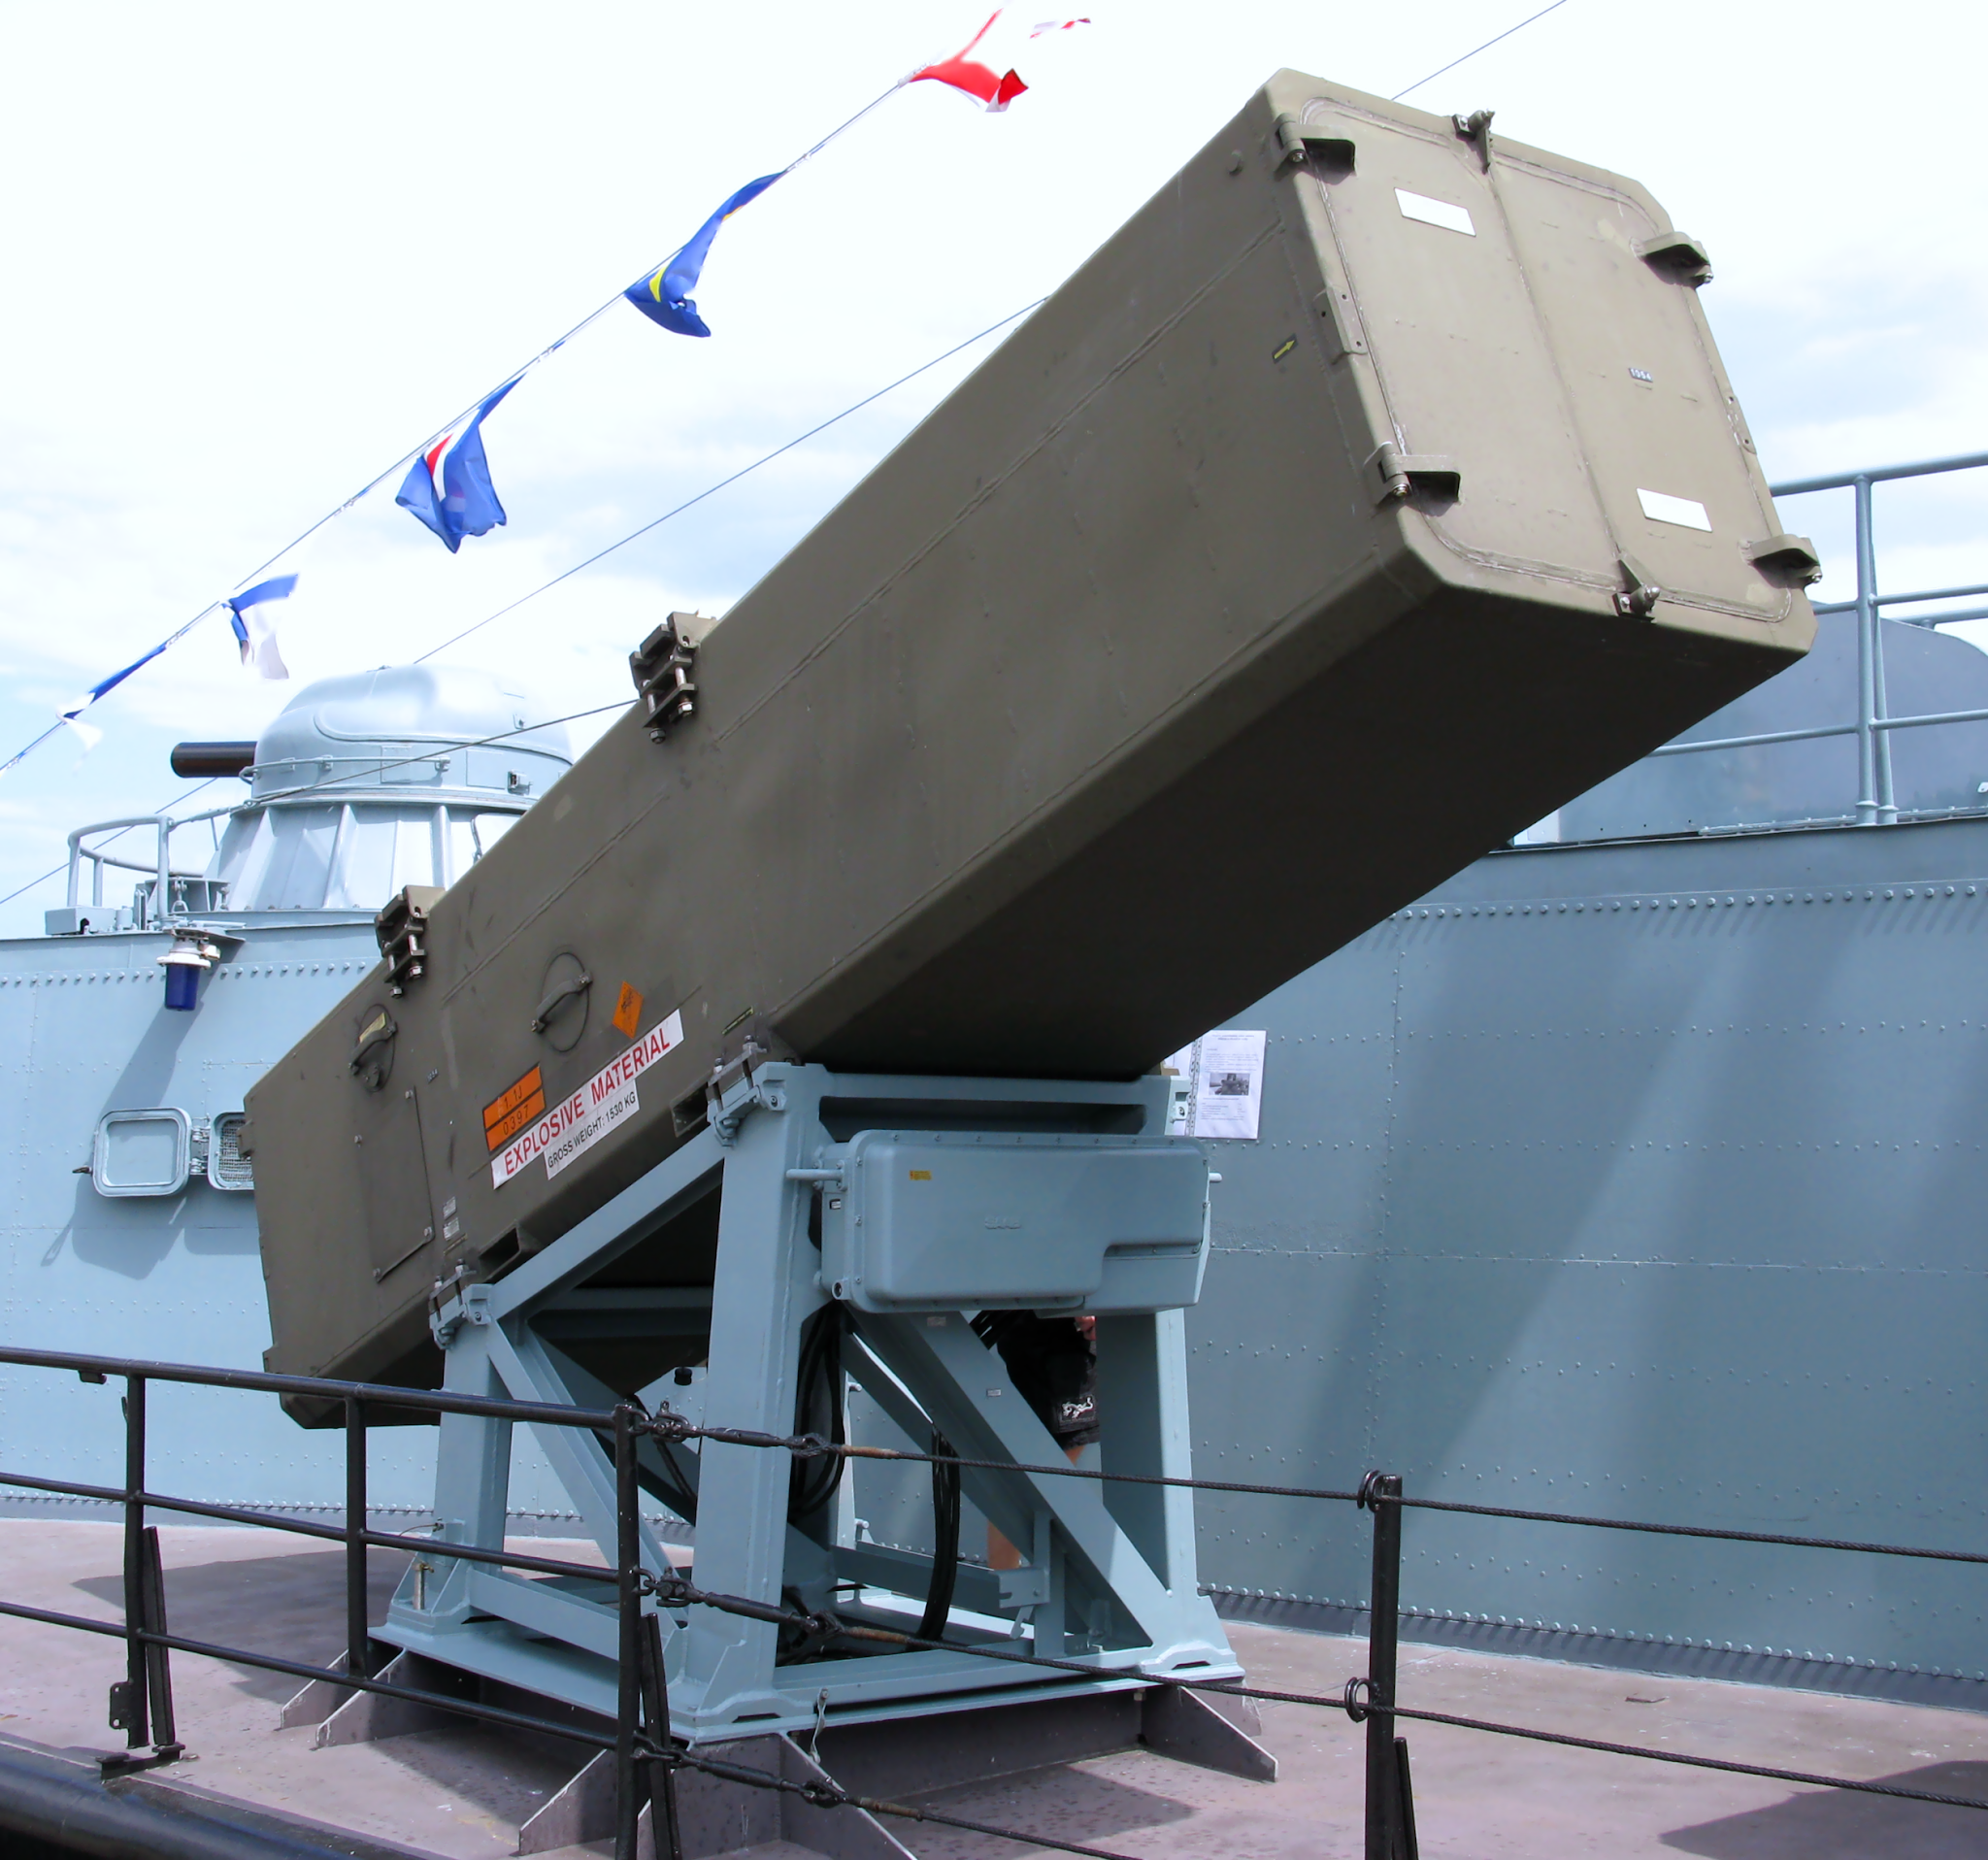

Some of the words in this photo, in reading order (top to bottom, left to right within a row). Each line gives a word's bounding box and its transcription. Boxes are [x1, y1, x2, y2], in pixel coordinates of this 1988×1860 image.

[503, 1104, 529, 1136] 0397
[505, 1093, 585, 1176] EXPLOSIVE
[591, 1028, 670, 1105] MATERIAL
[547, 1140, 574, 1168] GROSS
[573, 1116, 606, 1147] WEIGHT:
[605, 1101, 623, 1123] 1530
[624, 1091, 636, 1109] KG
